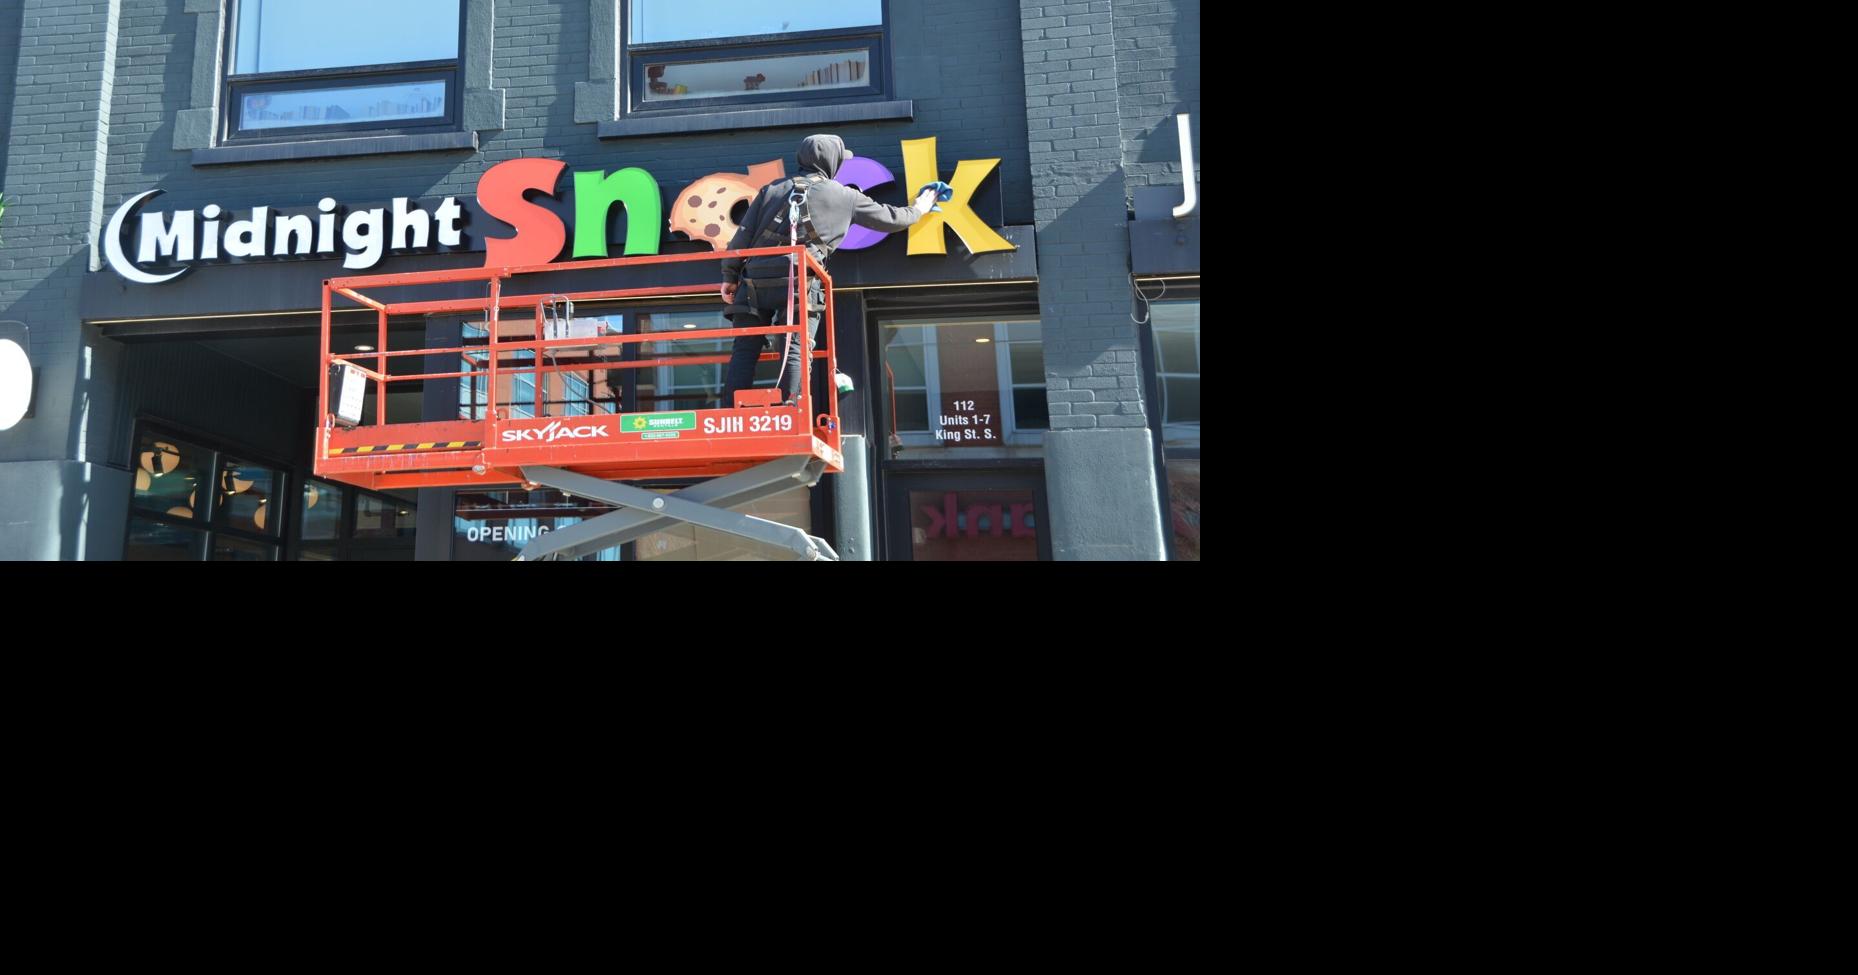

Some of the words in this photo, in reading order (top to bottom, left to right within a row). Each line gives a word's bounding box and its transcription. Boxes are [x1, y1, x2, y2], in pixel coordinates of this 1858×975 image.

[137, 196, 462, 270] Midnight
[953, 400, 975, 411] 112
[749, 414, 793, 432] 3219
[939, 415, 969, 426] Units
[972, 414, 991, 425] 1-7
[501, 420, 609, 443] SKYJACK
[935, 428, 961, 441] King
[964, 429, 980, 440] St.
[984, 428, 997, 439] S.
